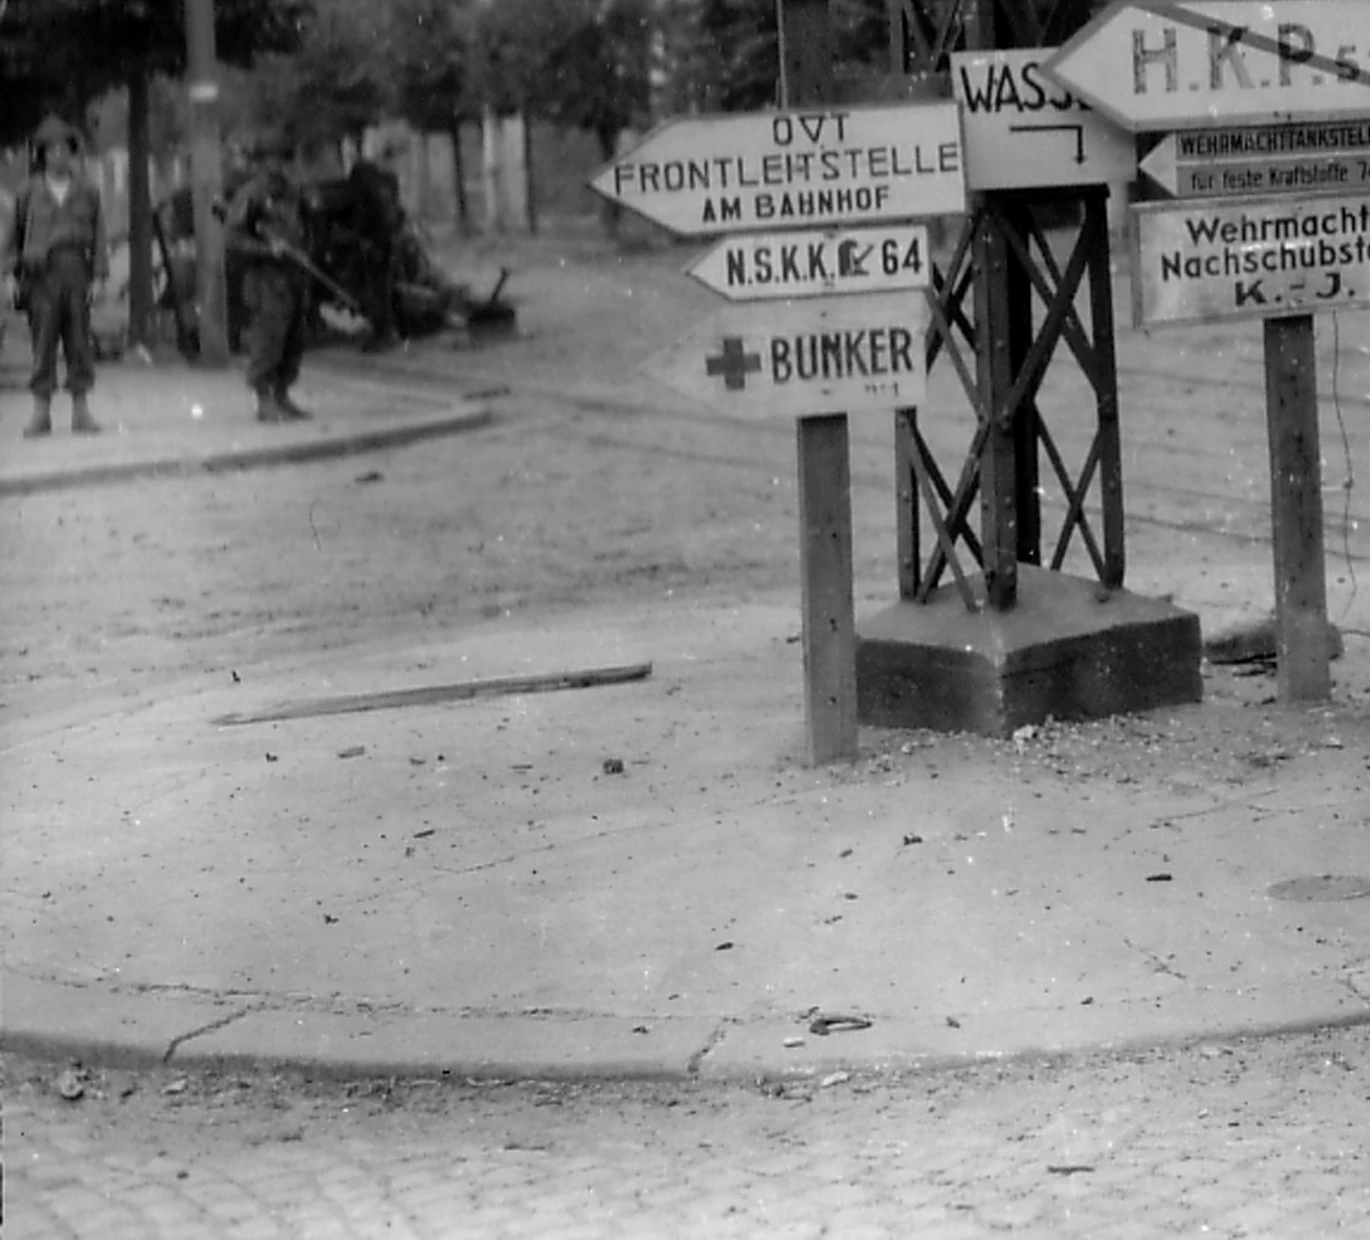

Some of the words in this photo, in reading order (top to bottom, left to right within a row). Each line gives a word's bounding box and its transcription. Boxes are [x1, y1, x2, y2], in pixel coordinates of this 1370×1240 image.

[613, 141, 960, 196] FRONTLEITSTELLE
[702, 195, 742, 224] AM
[754, 186, 891, 220] BAHNHOF
[882, 237, 924, 277] 64
[771, 327, 914, 385] BUNKER
